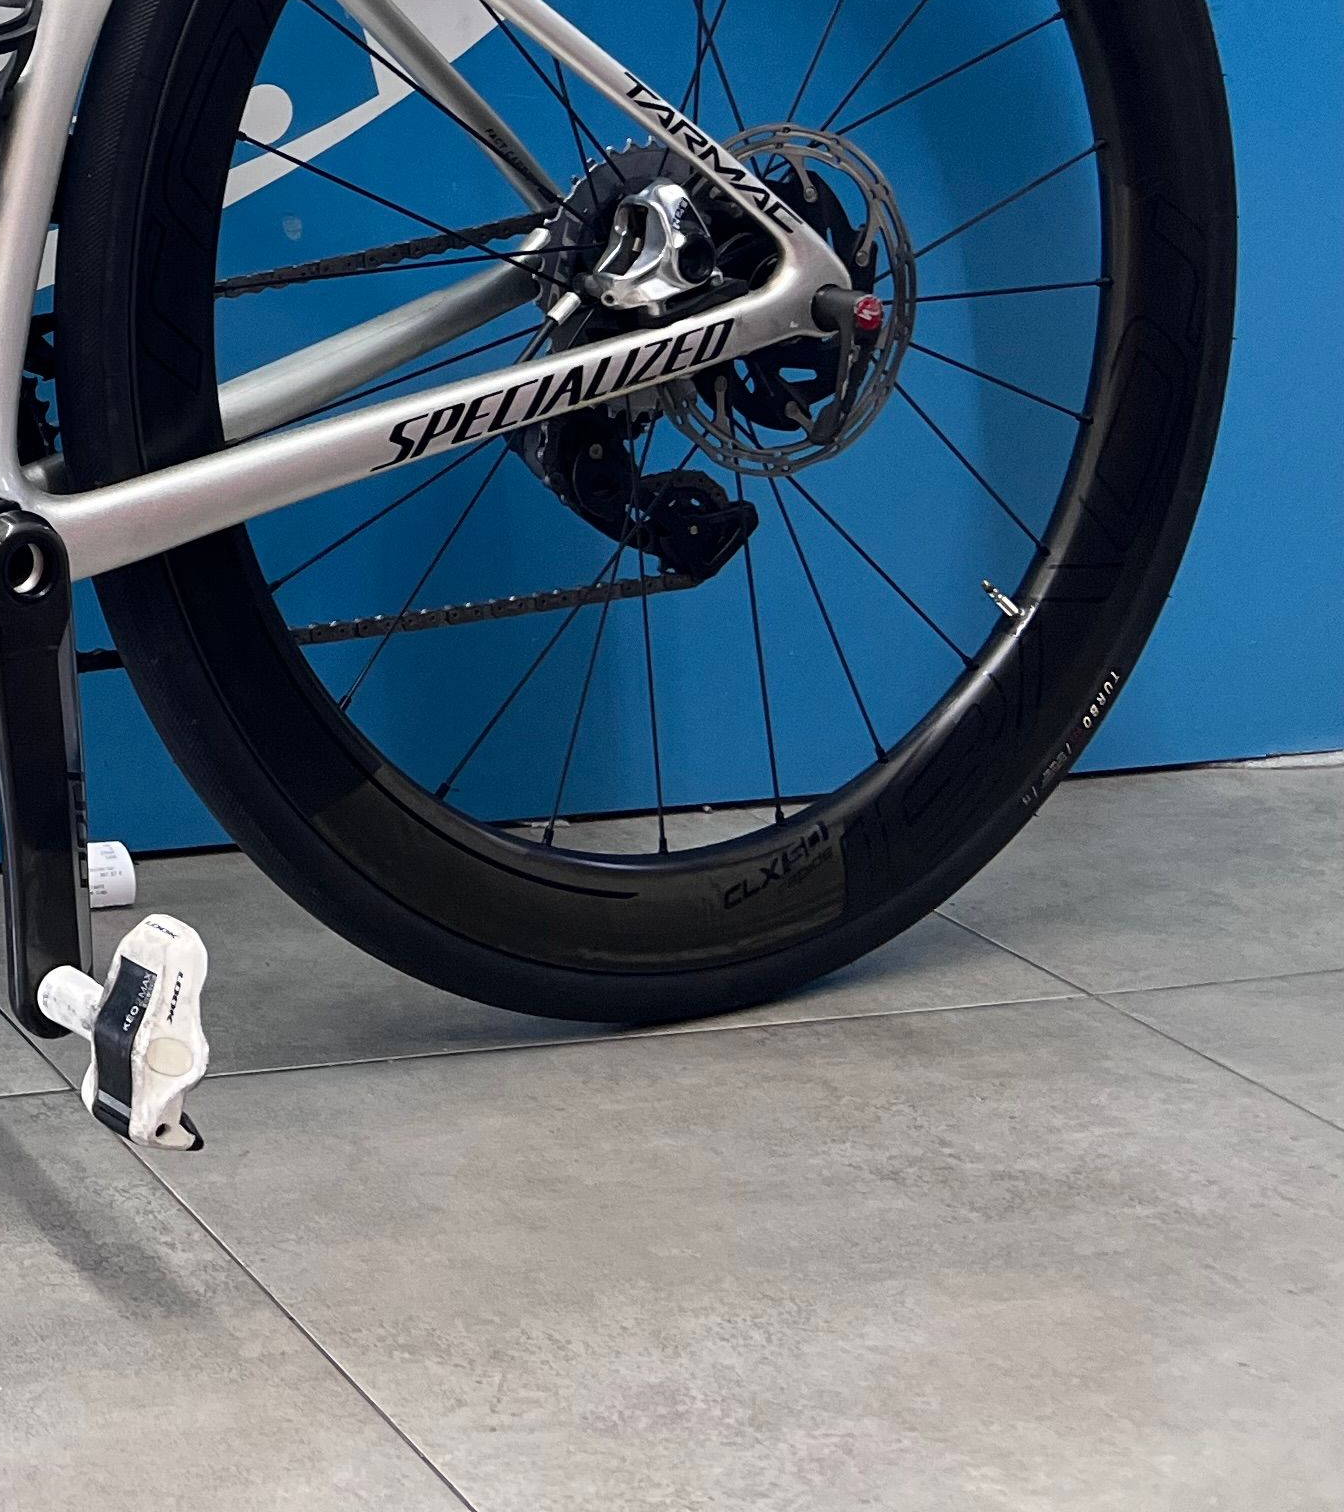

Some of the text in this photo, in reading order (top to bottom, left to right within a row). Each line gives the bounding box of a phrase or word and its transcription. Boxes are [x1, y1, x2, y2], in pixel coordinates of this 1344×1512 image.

[622, 71, 803, 235] TARMAC
[369, 318, 736, 472] SPECIALIZED
[1081, 668, 1121, 731] TURBO
[145, 920, 178, 939] LOOK
[166, 970, 184, 1025] LOOK
